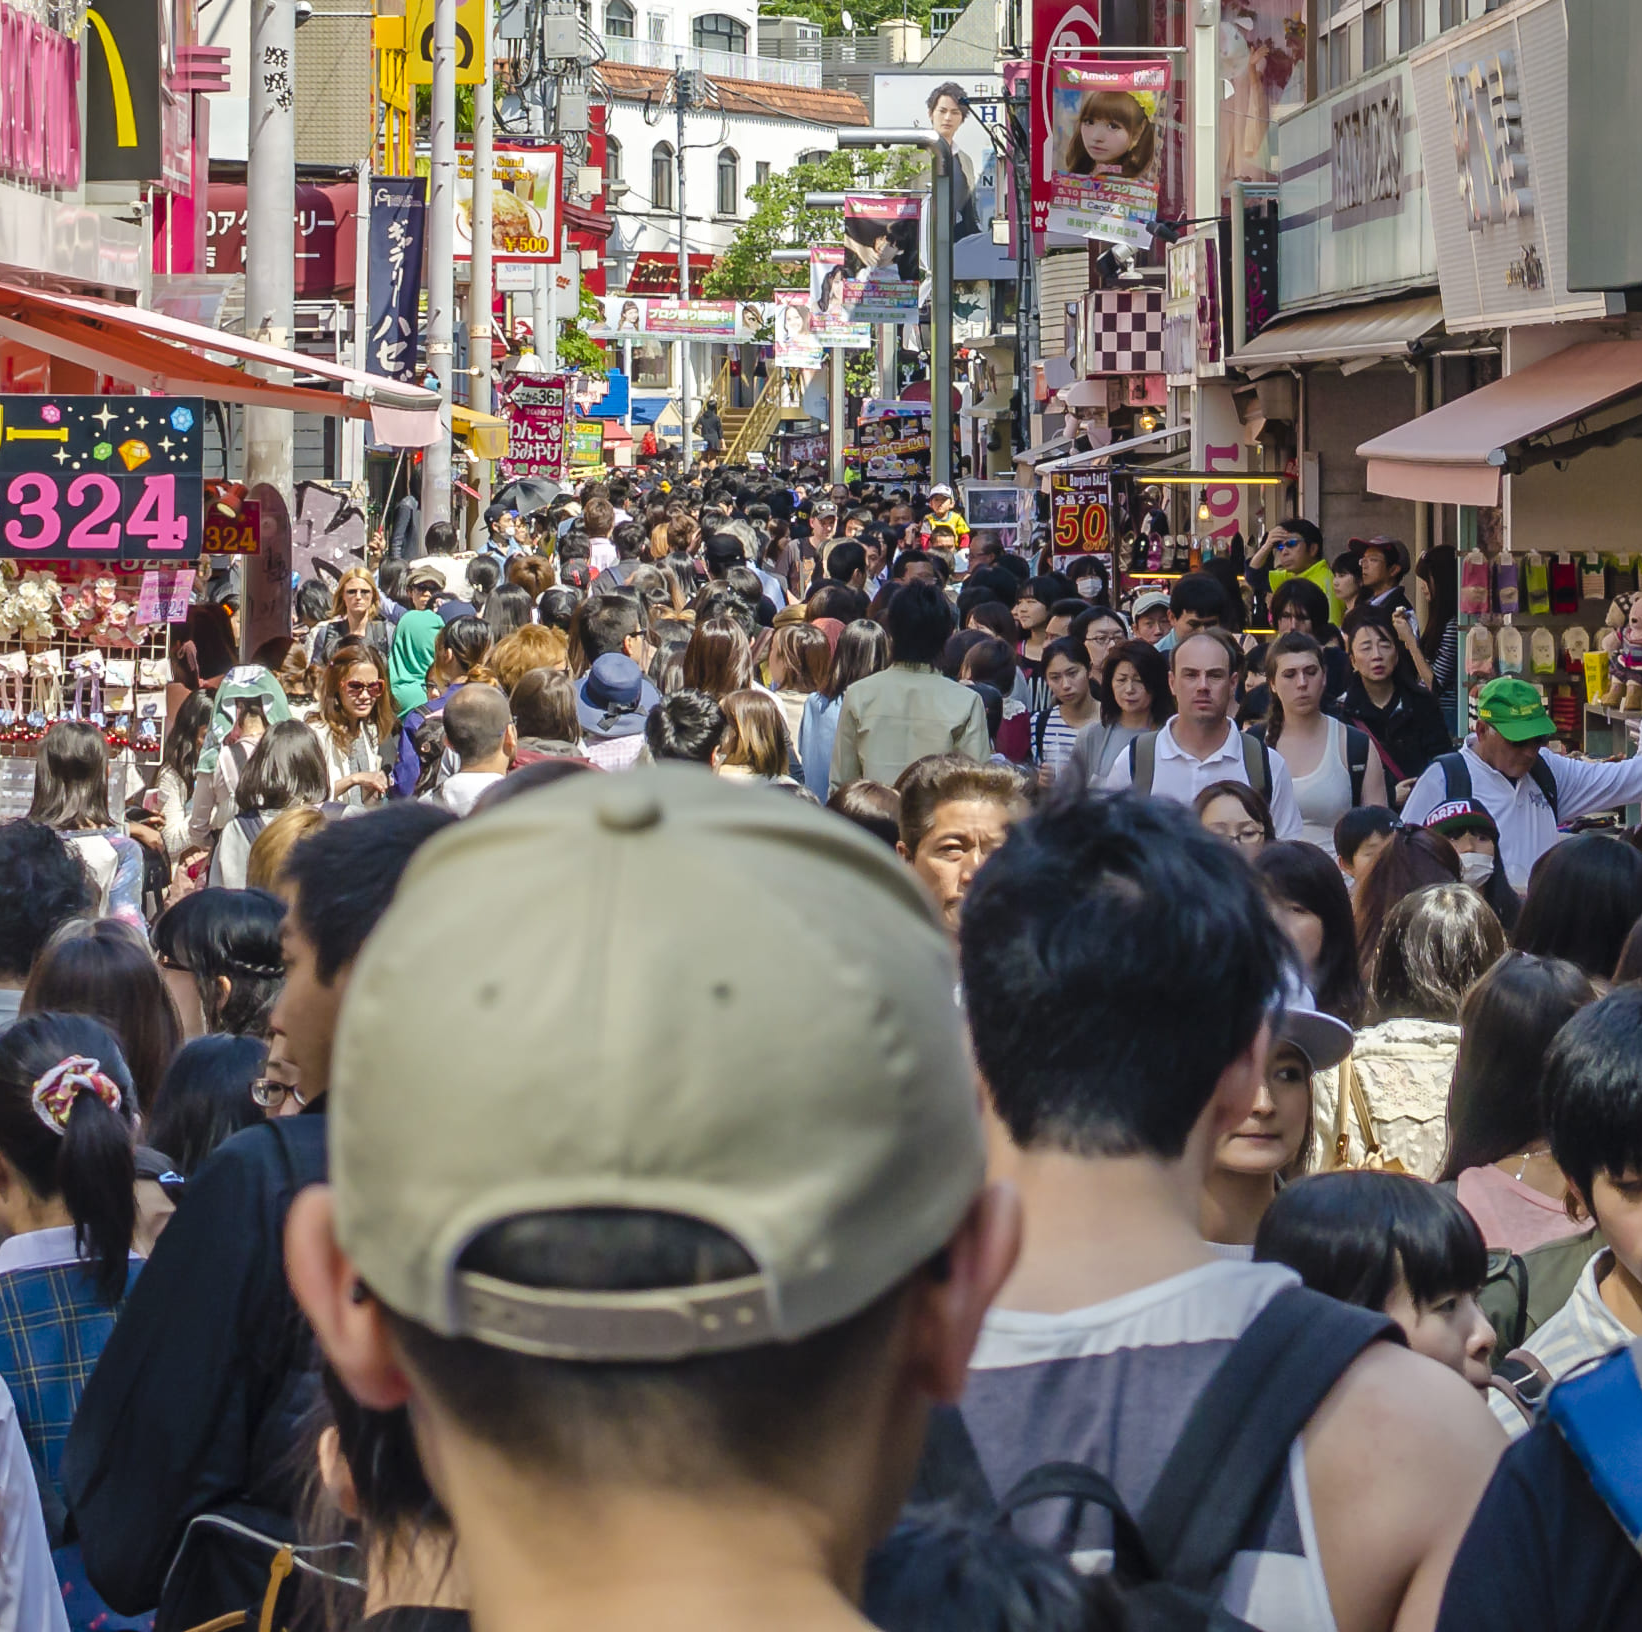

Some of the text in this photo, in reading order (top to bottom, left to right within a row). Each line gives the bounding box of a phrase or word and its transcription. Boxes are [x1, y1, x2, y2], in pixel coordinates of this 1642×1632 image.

[388, 219, 414, 308] ギャラリー
[503, 236, 549, 253] ¥500
[372, 314, 413, 381] ハセ
[1055, 503, 1107, 546] 50
